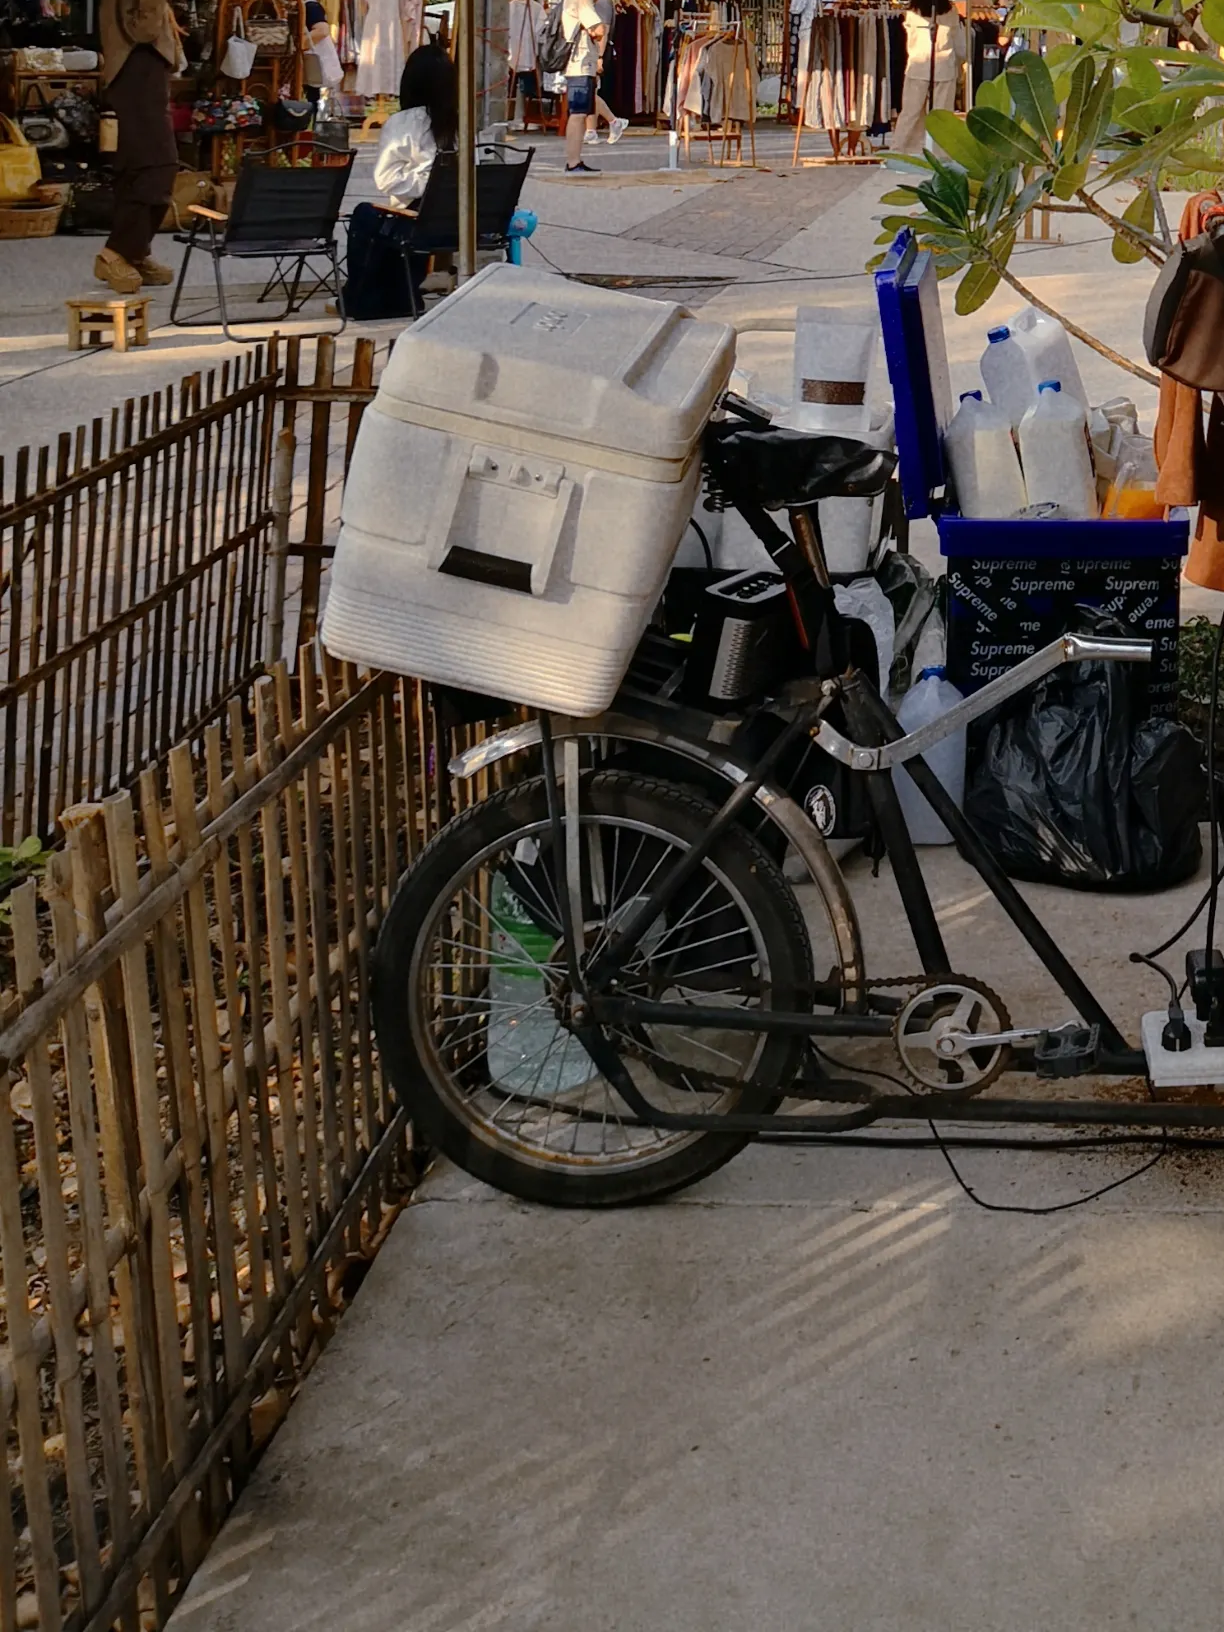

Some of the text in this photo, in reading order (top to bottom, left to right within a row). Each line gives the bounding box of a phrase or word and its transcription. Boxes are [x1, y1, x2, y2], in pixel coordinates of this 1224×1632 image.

[1010, 576, 1075, 595] Supreme
[948, 571, 999, 622] Supreme
[970, 640, 1035, 660] Supreme
